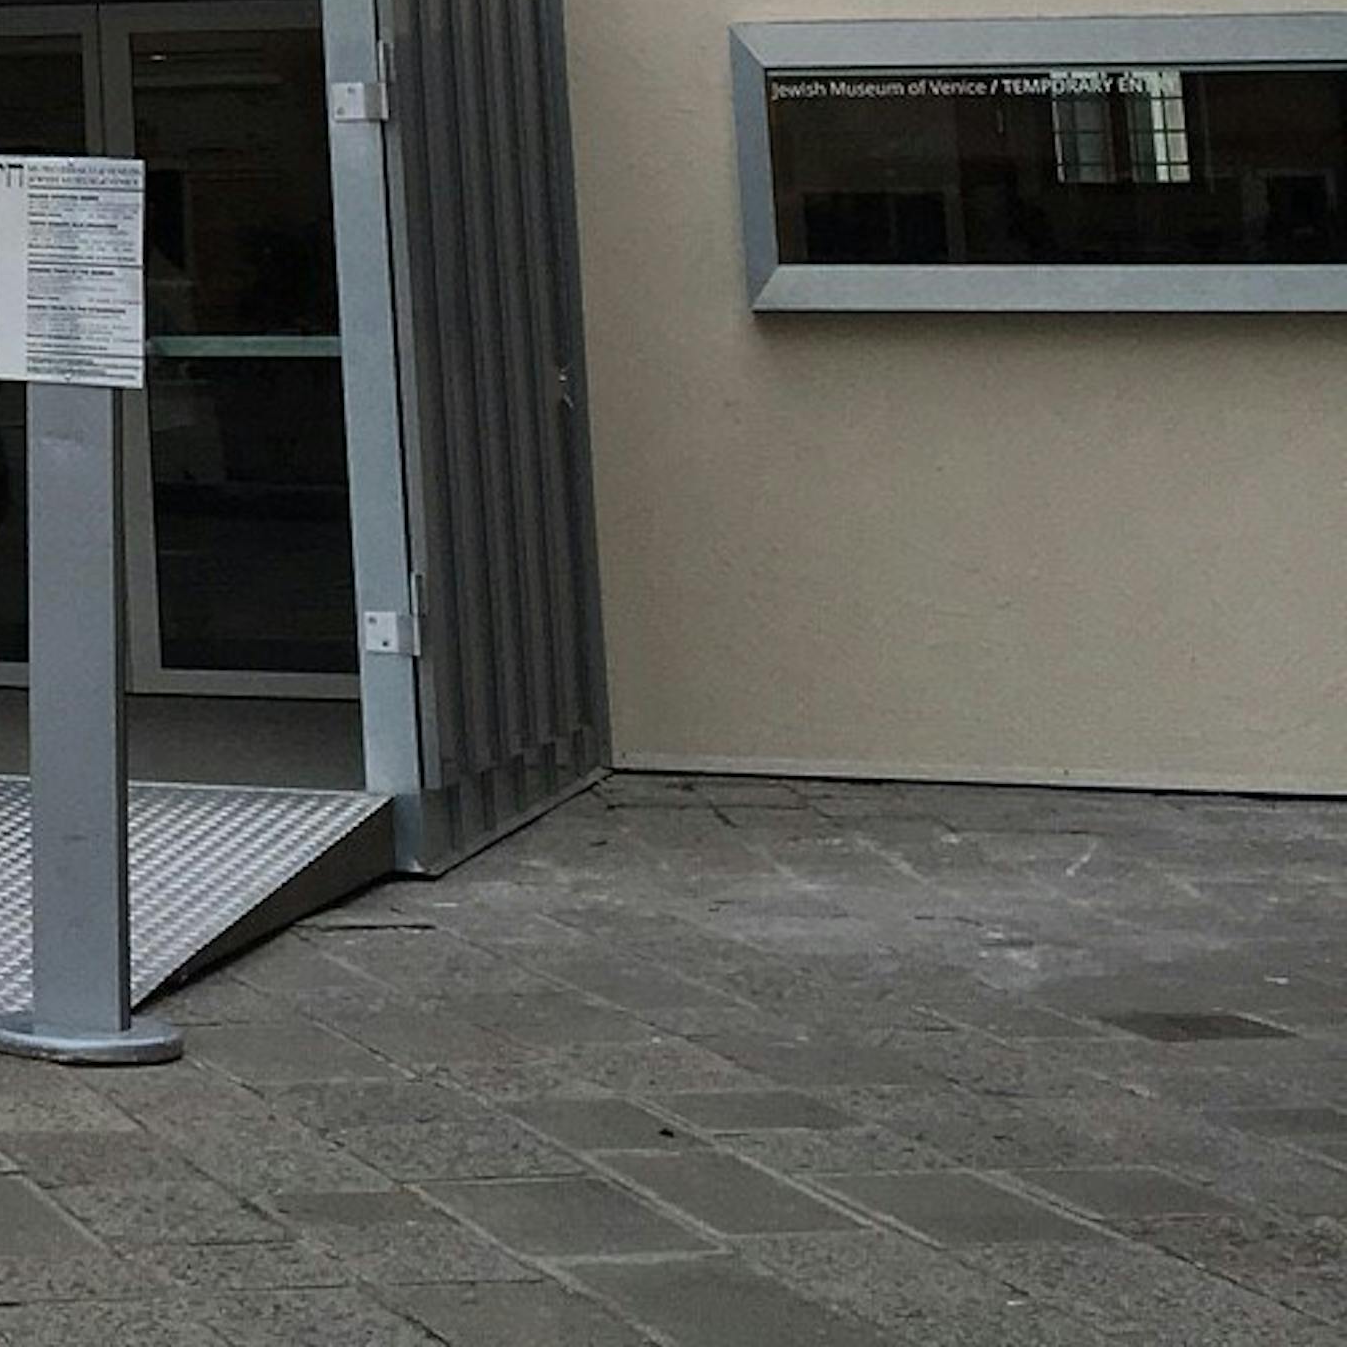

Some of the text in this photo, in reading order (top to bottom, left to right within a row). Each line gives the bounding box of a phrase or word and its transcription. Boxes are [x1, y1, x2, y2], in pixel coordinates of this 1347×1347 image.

[771, 81, 827, 101] Jewish
[829, 80, 905, 97] Museum
[908, 78, 926, 96] of
[928, 78, 988, 96] Venice
[1001, 76, 1113, 96] TEMPORARY
